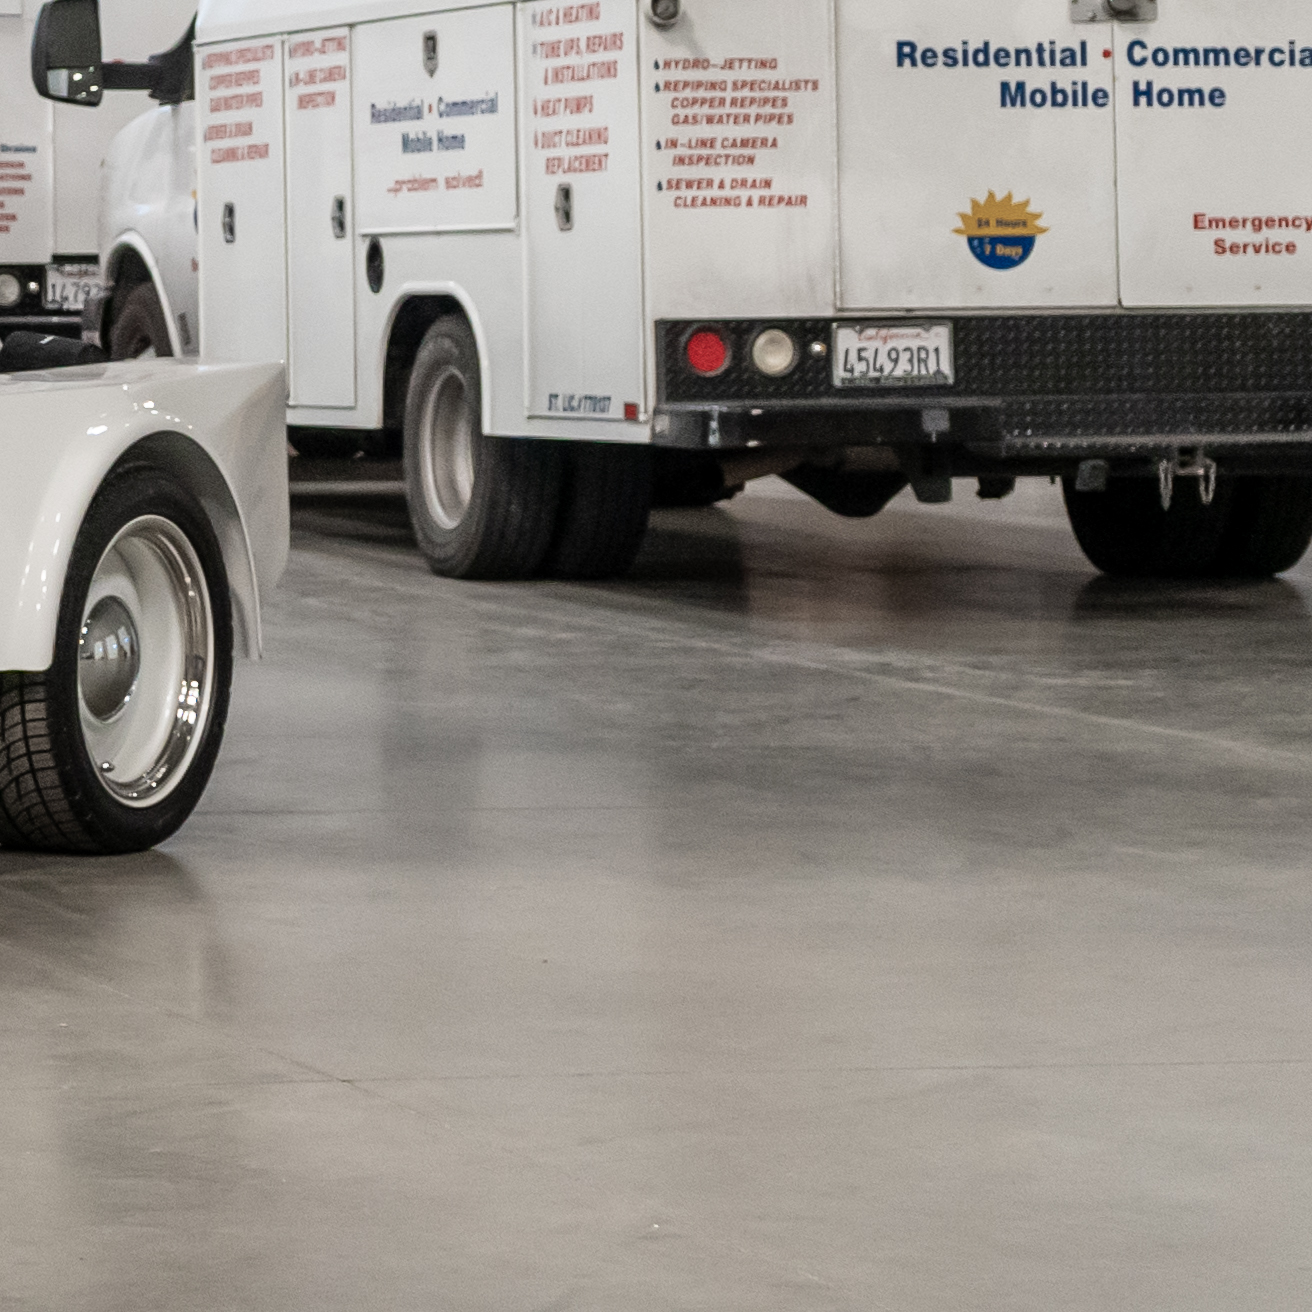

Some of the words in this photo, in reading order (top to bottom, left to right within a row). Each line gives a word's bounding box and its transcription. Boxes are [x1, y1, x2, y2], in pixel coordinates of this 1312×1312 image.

[563, 1, 601, 23] HEATING
[585, 32, 624, 54] REPAIRS
[895, 39, 1088, 68] Residential
[662, 57, 778, 70] HYDRO-JETTING
[662, 79, 728, 92] REPIPING
[731, 79, 820, 92] SPECIALISTS
[999, 81, 1110, 108] Mobile
[1132, 80, 1226, 107] Home
[437, 90, 498, 118] Commercial
[540, 98, 563, 118] HEAT
[564, 95, 594, 115] PUMPS
[671, 96, 726, 109] COPPER
[730, 96, 789, 109] REPIPES
[671, 113, 751, 126] GAS/WATER
[754, 113, 794, 125] PIPES
[565, 126, 609, 147] CLEANING
[664, 137, 717, 150] IN-LINE
[720, 136, 778, 149] CAMERA
[545, 152, 609, 175] REPLACEMENT
[672, 153, 756, 166] INSPECTION
[666, 178, 714, 190] SEWER
[730, 178, 773, 190] DRAIN
[674, 195, 742, 208] CLEANING
[757, 195, 808, 207] REPAIR
[996, 219, 1027, 228] Hours
[995, 244, 1023, 257] Days
[1213, 238, 1297, 255] Service
[843, 345, 941, 376] 45493R1
